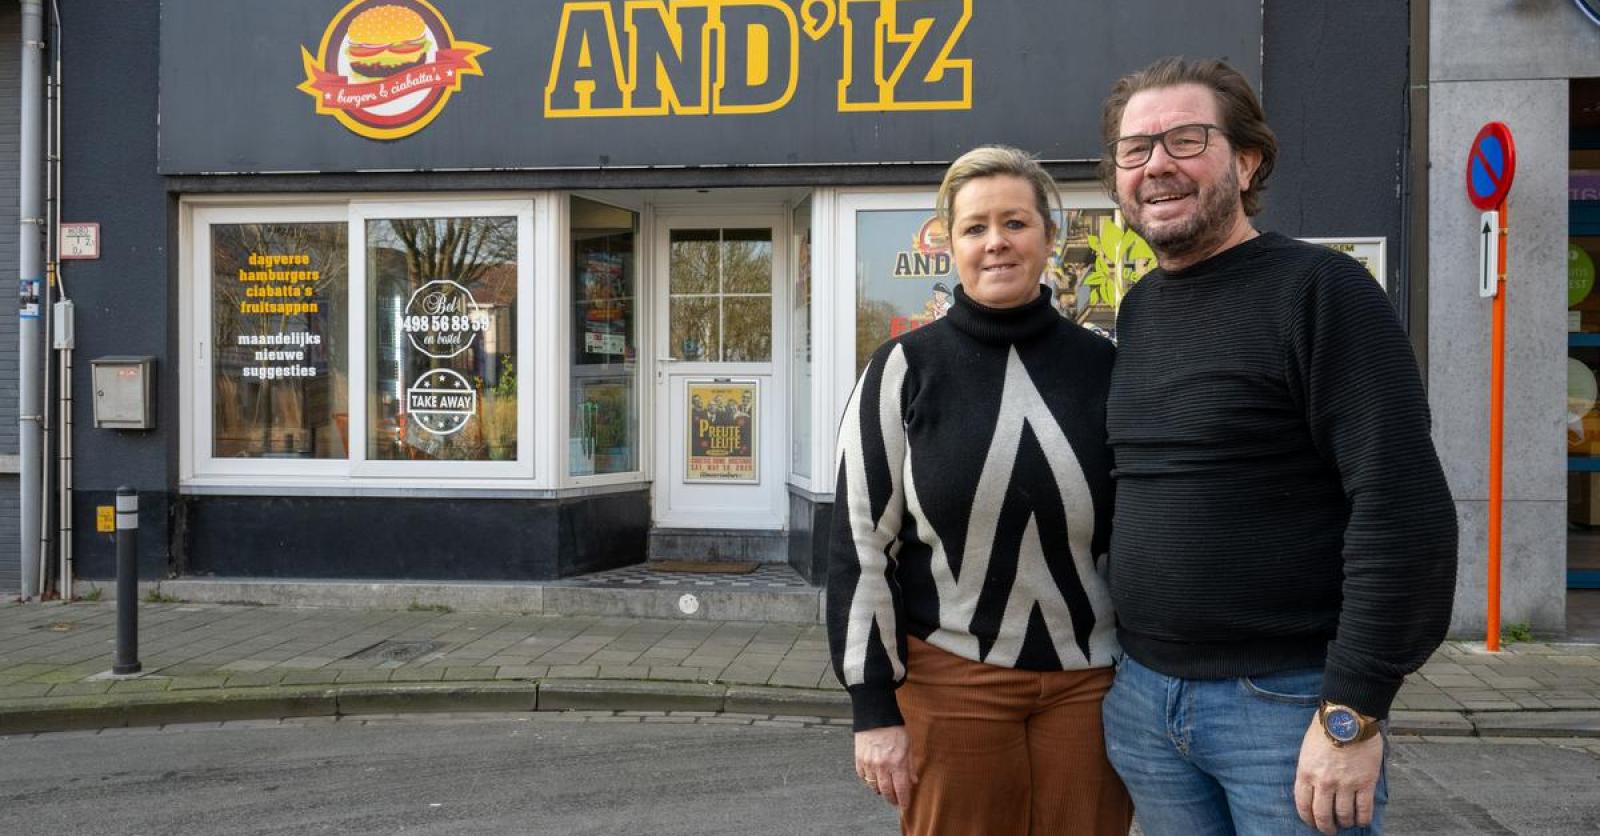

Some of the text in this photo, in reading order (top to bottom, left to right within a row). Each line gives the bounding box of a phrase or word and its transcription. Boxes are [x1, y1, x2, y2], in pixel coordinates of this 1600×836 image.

[544, 0, 973, 118] AND'IZ
[337, 89, 377, 107] burgers
[391, 66, 441, 94] ciabatta's
[249, 252, 310, 267] dagverse
[239, 269, 321, 283] hamburgers
[246, 284, 314, 297] ciabatta's
[240, 301, 319, 316] fruitsappen
[422, 292, 458, 315] Bel
[432, 315, 449, 332] 56
[452, 316, 469, 332] 88
[238, 332, 321, 347] maandelijks
[255, 348, 305, 361] nieuwe
[243, 364, 317, 380] suggesties
[412, 395, 471, 408] TAKE AWAY
[699, 419, 742, 438] PREUTE
[711, 438, 742, 453] LEUTE
